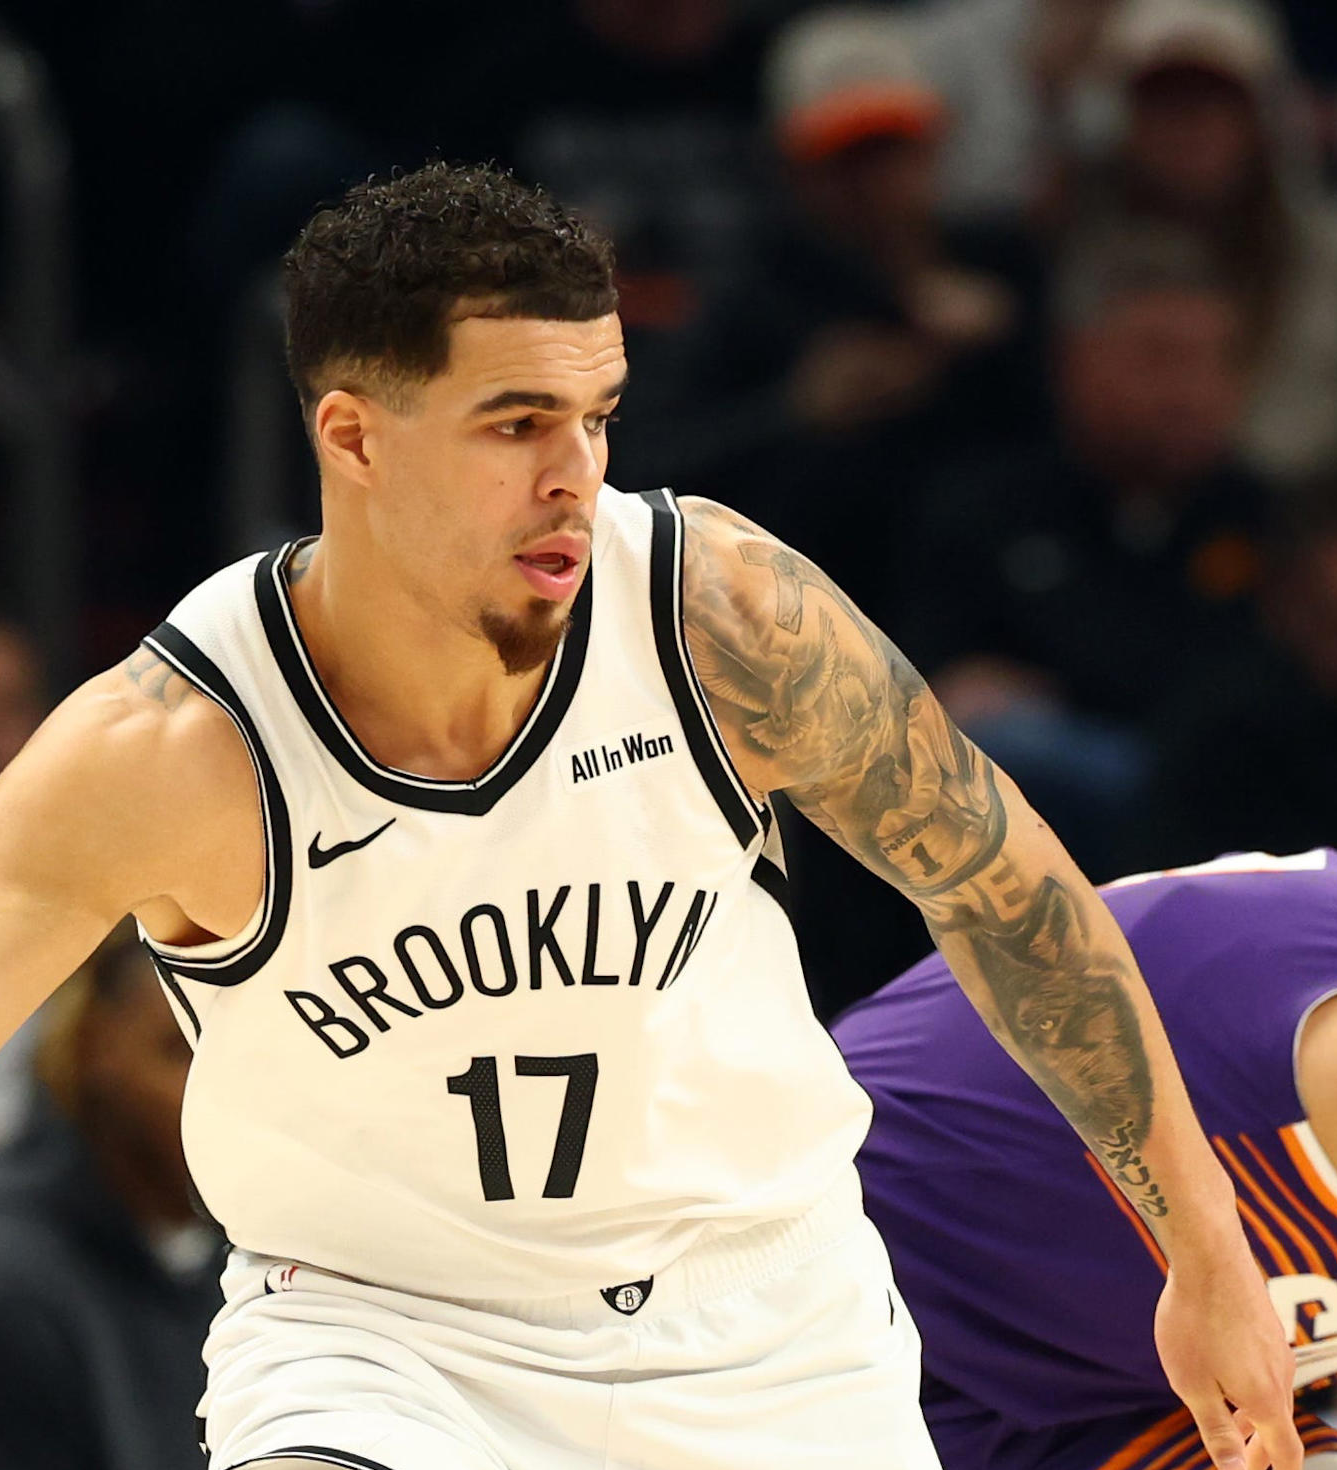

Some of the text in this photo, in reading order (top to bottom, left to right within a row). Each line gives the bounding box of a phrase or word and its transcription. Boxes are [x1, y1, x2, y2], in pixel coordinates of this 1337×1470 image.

[571, 732, 674, 784] All In Won
[283, 879, 719, 1060] BROOKLYN
[446, 1052, 599, 1202] 17
[624, 1289, 635, 1308] B
